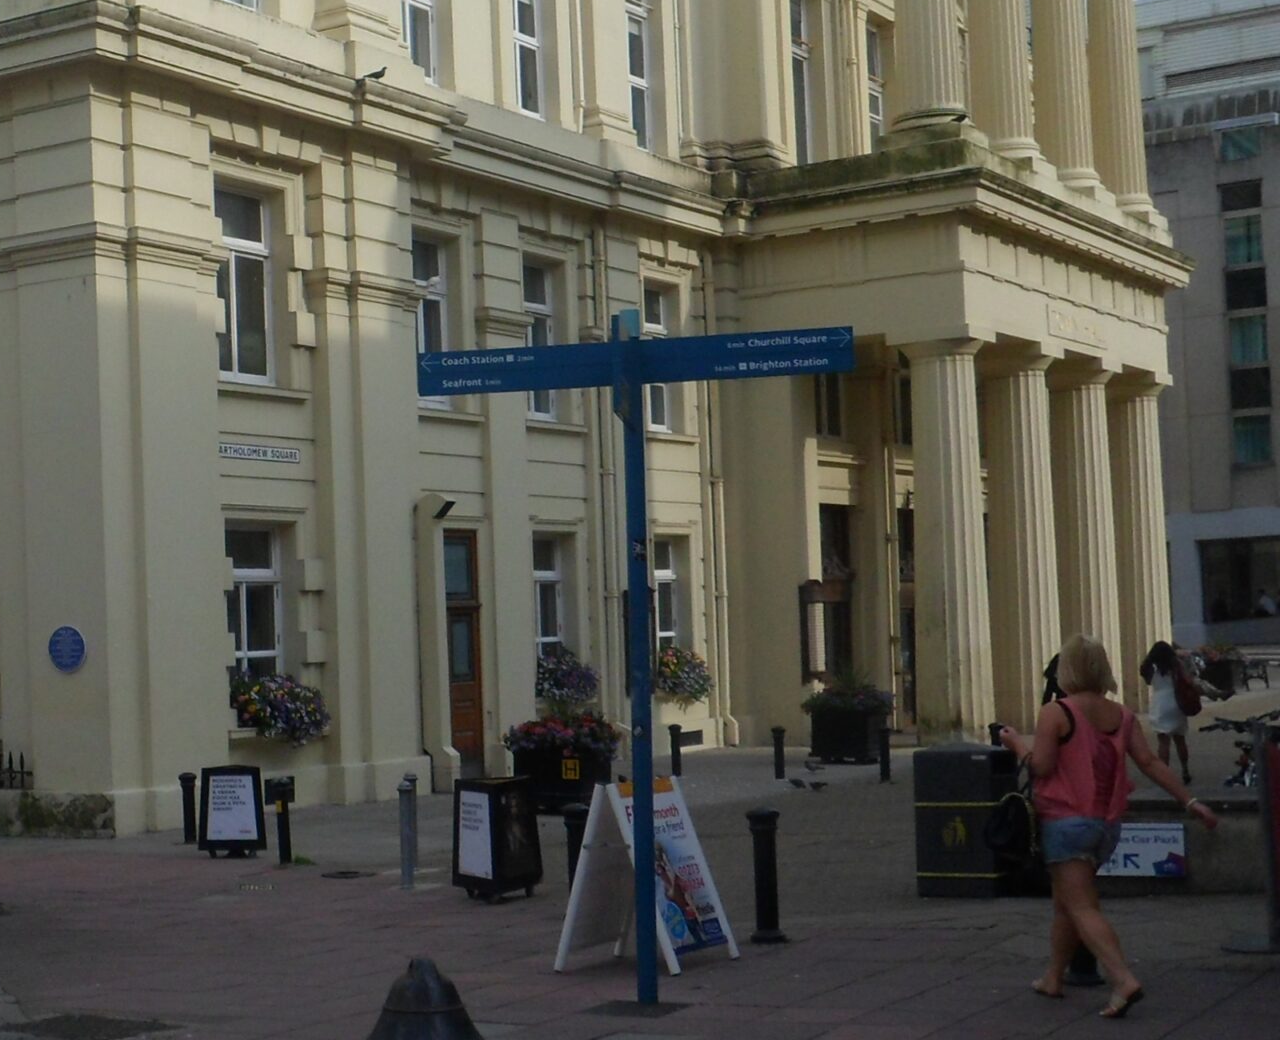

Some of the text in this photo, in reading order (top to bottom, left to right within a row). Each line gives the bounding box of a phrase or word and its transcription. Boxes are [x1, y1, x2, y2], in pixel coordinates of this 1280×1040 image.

[748, 336, 791, 347] Churchill
[793, 335, 827, 345] Square
[442, 356, 470, 367] Coach
[471, 354, 504, 365] Station
[749, 359, 791, 371] Brighton
[793, 356, 828, 367] Station
[442, 379, 482, 389] Seafront
[218, 445, 298, 461] ARTHOLOMEW SQUARE
[564, 760, 577, 778] H
[654, 803, 680, 820] month
[666, 818, 685, 835] friend
[1131, 835, 1151, 844] Car
[1154, 835, 1179, 844] Park
